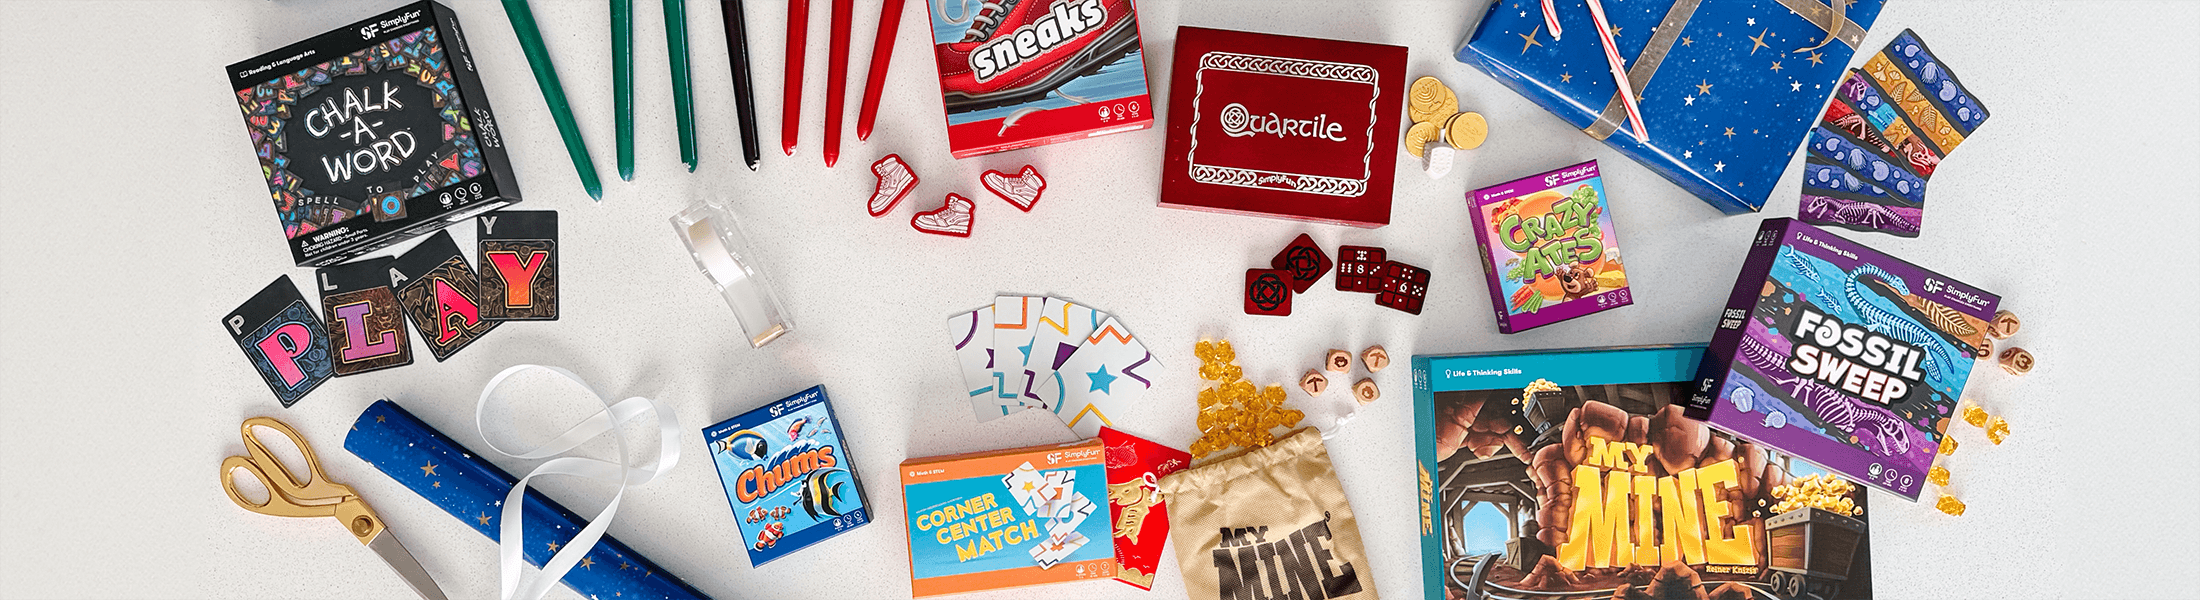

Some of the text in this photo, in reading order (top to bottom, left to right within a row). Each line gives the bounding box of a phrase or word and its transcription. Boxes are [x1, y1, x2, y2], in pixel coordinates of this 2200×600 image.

[361, 23, 379, 40] SF
[973, 0, 1103, 79] sneaks
[248, 63, 272, 76] Reading
[276, 54, 303, 66] Language
[304, 49, 316, 58] Arts
[306, 81, 402, 137] CHALK
[1220, 102, 1347, 142] Quartile
[321, 131, 416, 182] WORD
[298, 151, 439, 207] SPELL TO PLAY
[1257, 174, 1298, 188] SimplyFun
[1544, 173, 1560, 187] SF
[312, 226, 350, 243] WARNING:
[480, 216, 498, 234] Y
[1499, 197, 1597, 252] CRAZY
[1523, 227, 1603, 284] ATES
[1802, 235, 1813, 244] Life
[1819, 240, 1842, 256] Thinking
[1842, 250, 1858, 260] Skills
[320, 272, 338, 291] L
[387, 267, 409, 288] A
[486, 250, 549, 309] Y
[1357, 264, 1364, 274] 8
[1923, 277, 1944, 294] SF
[1946, 284, 1989, 306] SimplyFun
[228, 315, 245, 336] P
[433, 276, 480, 346] A
[1720, 318, 1742, 330] SWEEP
[1724, 308, 1747, 320] FOSSIL
[333, 300, 401, 364] L
[1795, 309, 1921, 381] FOSSIL
[255, 321, 314, 391] P
[1472, 369, 1502, 377] Thinking
[1789, 344, 1907, 405] SWEEP
[2015, 354, 2032, 370] 3
[769, 404, 786, 418] SF
[1046, 452, 1062, 464] SF
[1588, 436, 1653, 473] MY
[736, 445, 837, 503] Chums
[916, 492, 998, 531] CORNER
[936, 507, 1016, 544] CENTER
[1558, 458, 1758, 571] MINE
[955, 519, 1039, 563] MATCH
[1220, 525, 1269, 548] MY
[1213, 519, 1363, 600] MINE
